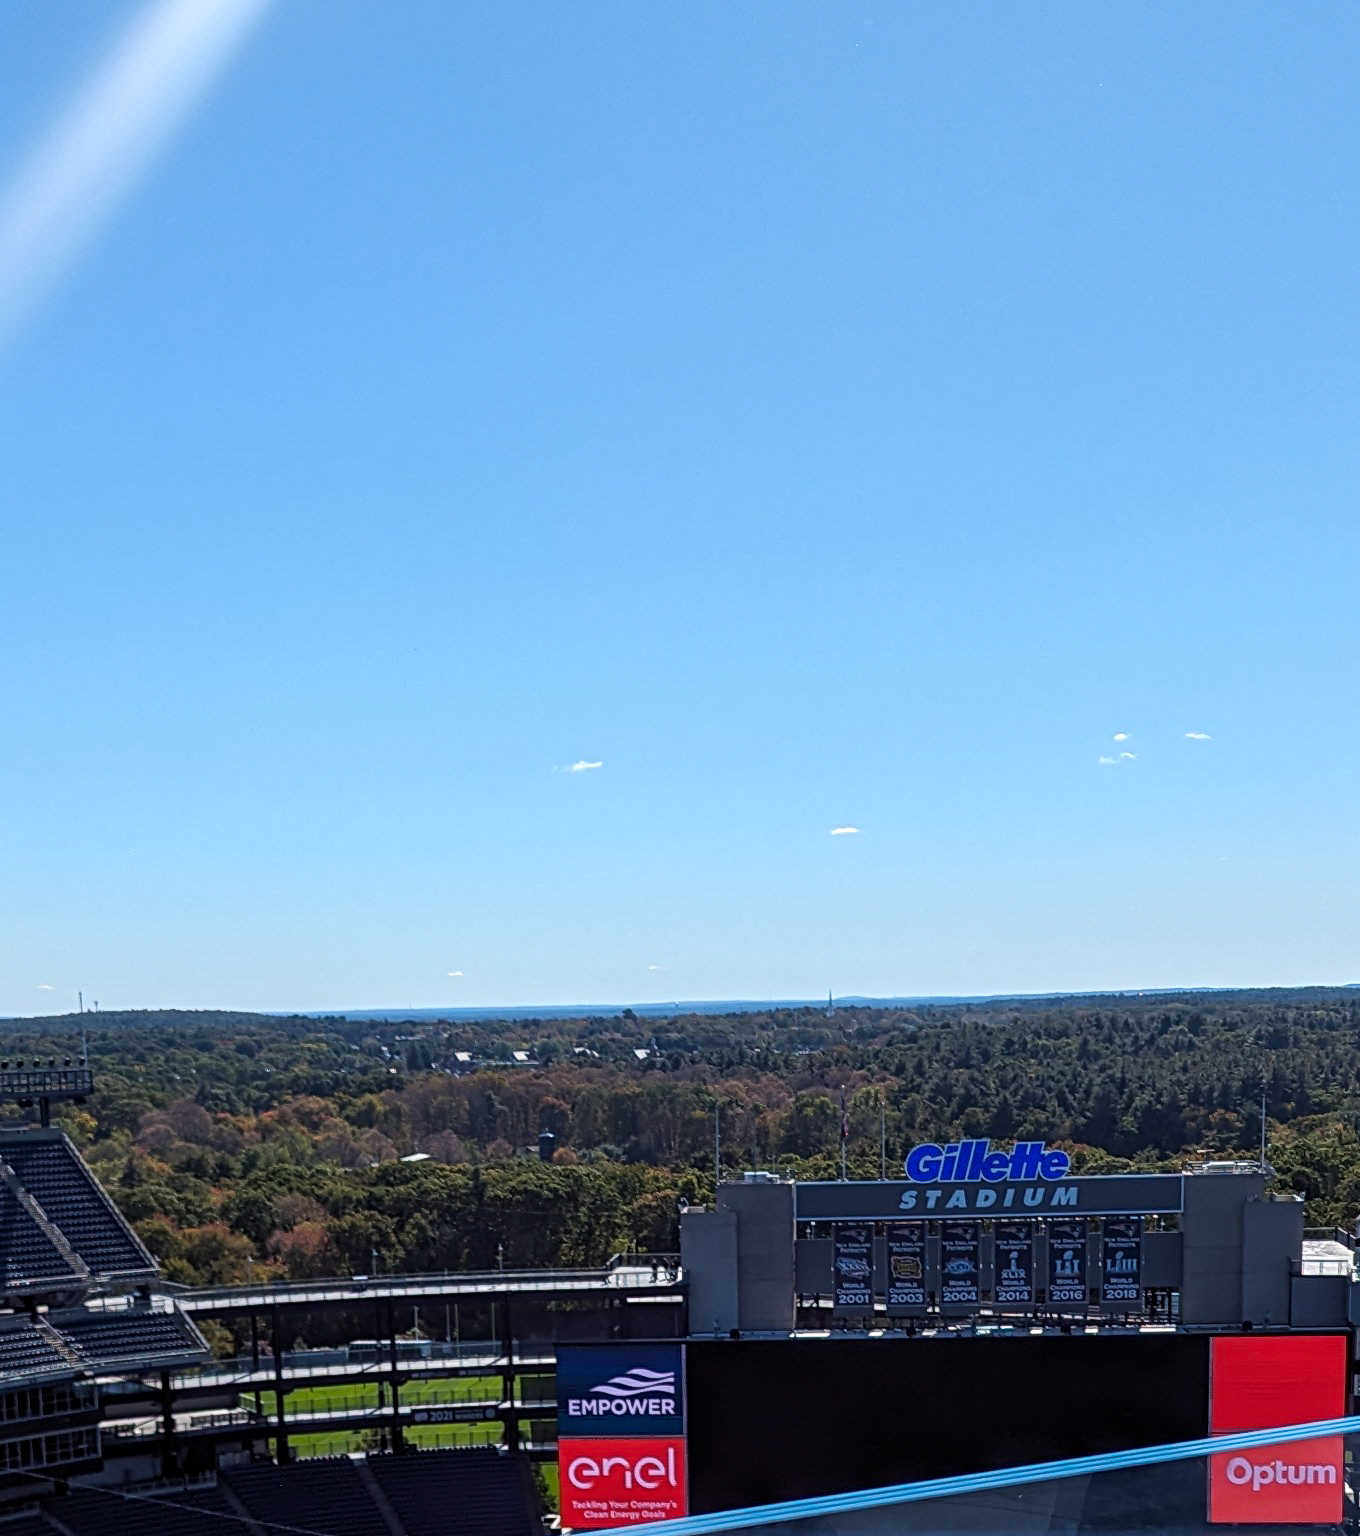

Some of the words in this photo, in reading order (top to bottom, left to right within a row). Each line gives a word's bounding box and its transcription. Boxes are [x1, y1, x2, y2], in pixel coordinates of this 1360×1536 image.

[904, 1138, 1071, 1183] Gillette
[898, 1187, 1079, 1210] STADIUM
[839, 1295, 869, 1304] 2001
[890, 1294, 923, 1303] 2003
[943, 1292, 977, 1301] 2004
[998, 1292, 1029, 1301] 2014
[1052, 1291, 1083, 1300] 2016
[1106, 1290, 1137, 1299] 2018
[568, 1399, 675, 1416] EMPOWER
[429, 1410, 453, 1421] 2021
[568, 1447, 677, 1490] enel
[1226, 1457, 1336, 1491] Optum
[572, 1500, 608, 1511] Tackling
[609, 1500, 629, 1509] Your
[630, 1500, 677, 1511] Company's
[583, 1510, 609, 1519] Clean
[610, 1510, 640, 1520] Energy
[641, 1510, 666, 1519] Goals
